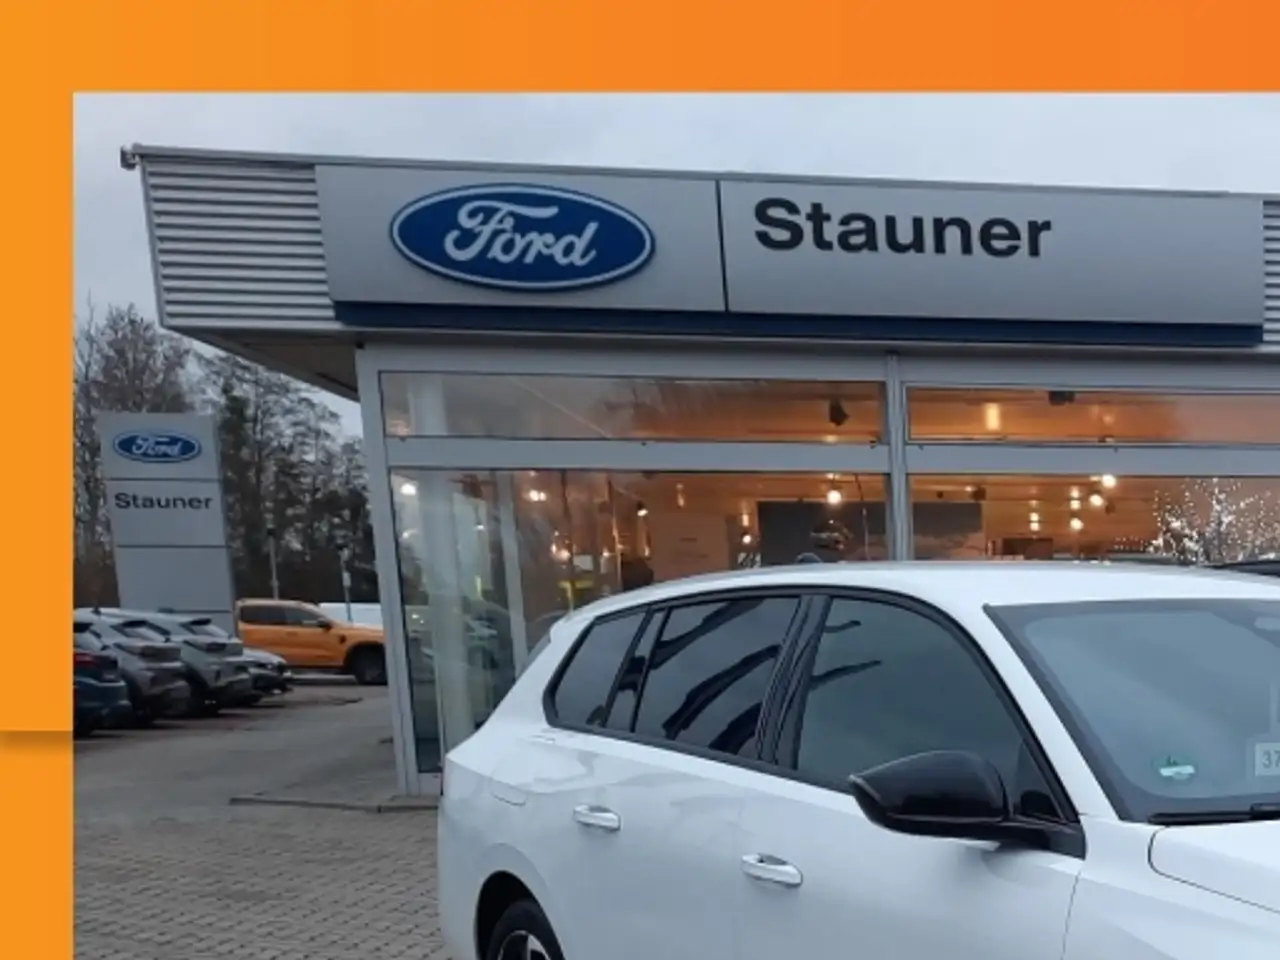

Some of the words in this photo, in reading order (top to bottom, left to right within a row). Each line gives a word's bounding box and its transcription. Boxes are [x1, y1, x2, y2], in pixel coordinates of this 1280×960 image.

[444, 199, 599, 267] Ford
[754, 197, 1052, 258] Stauner
[131, 435, 182, 457] Ford
[114, 492, 213, 509] Stauner
